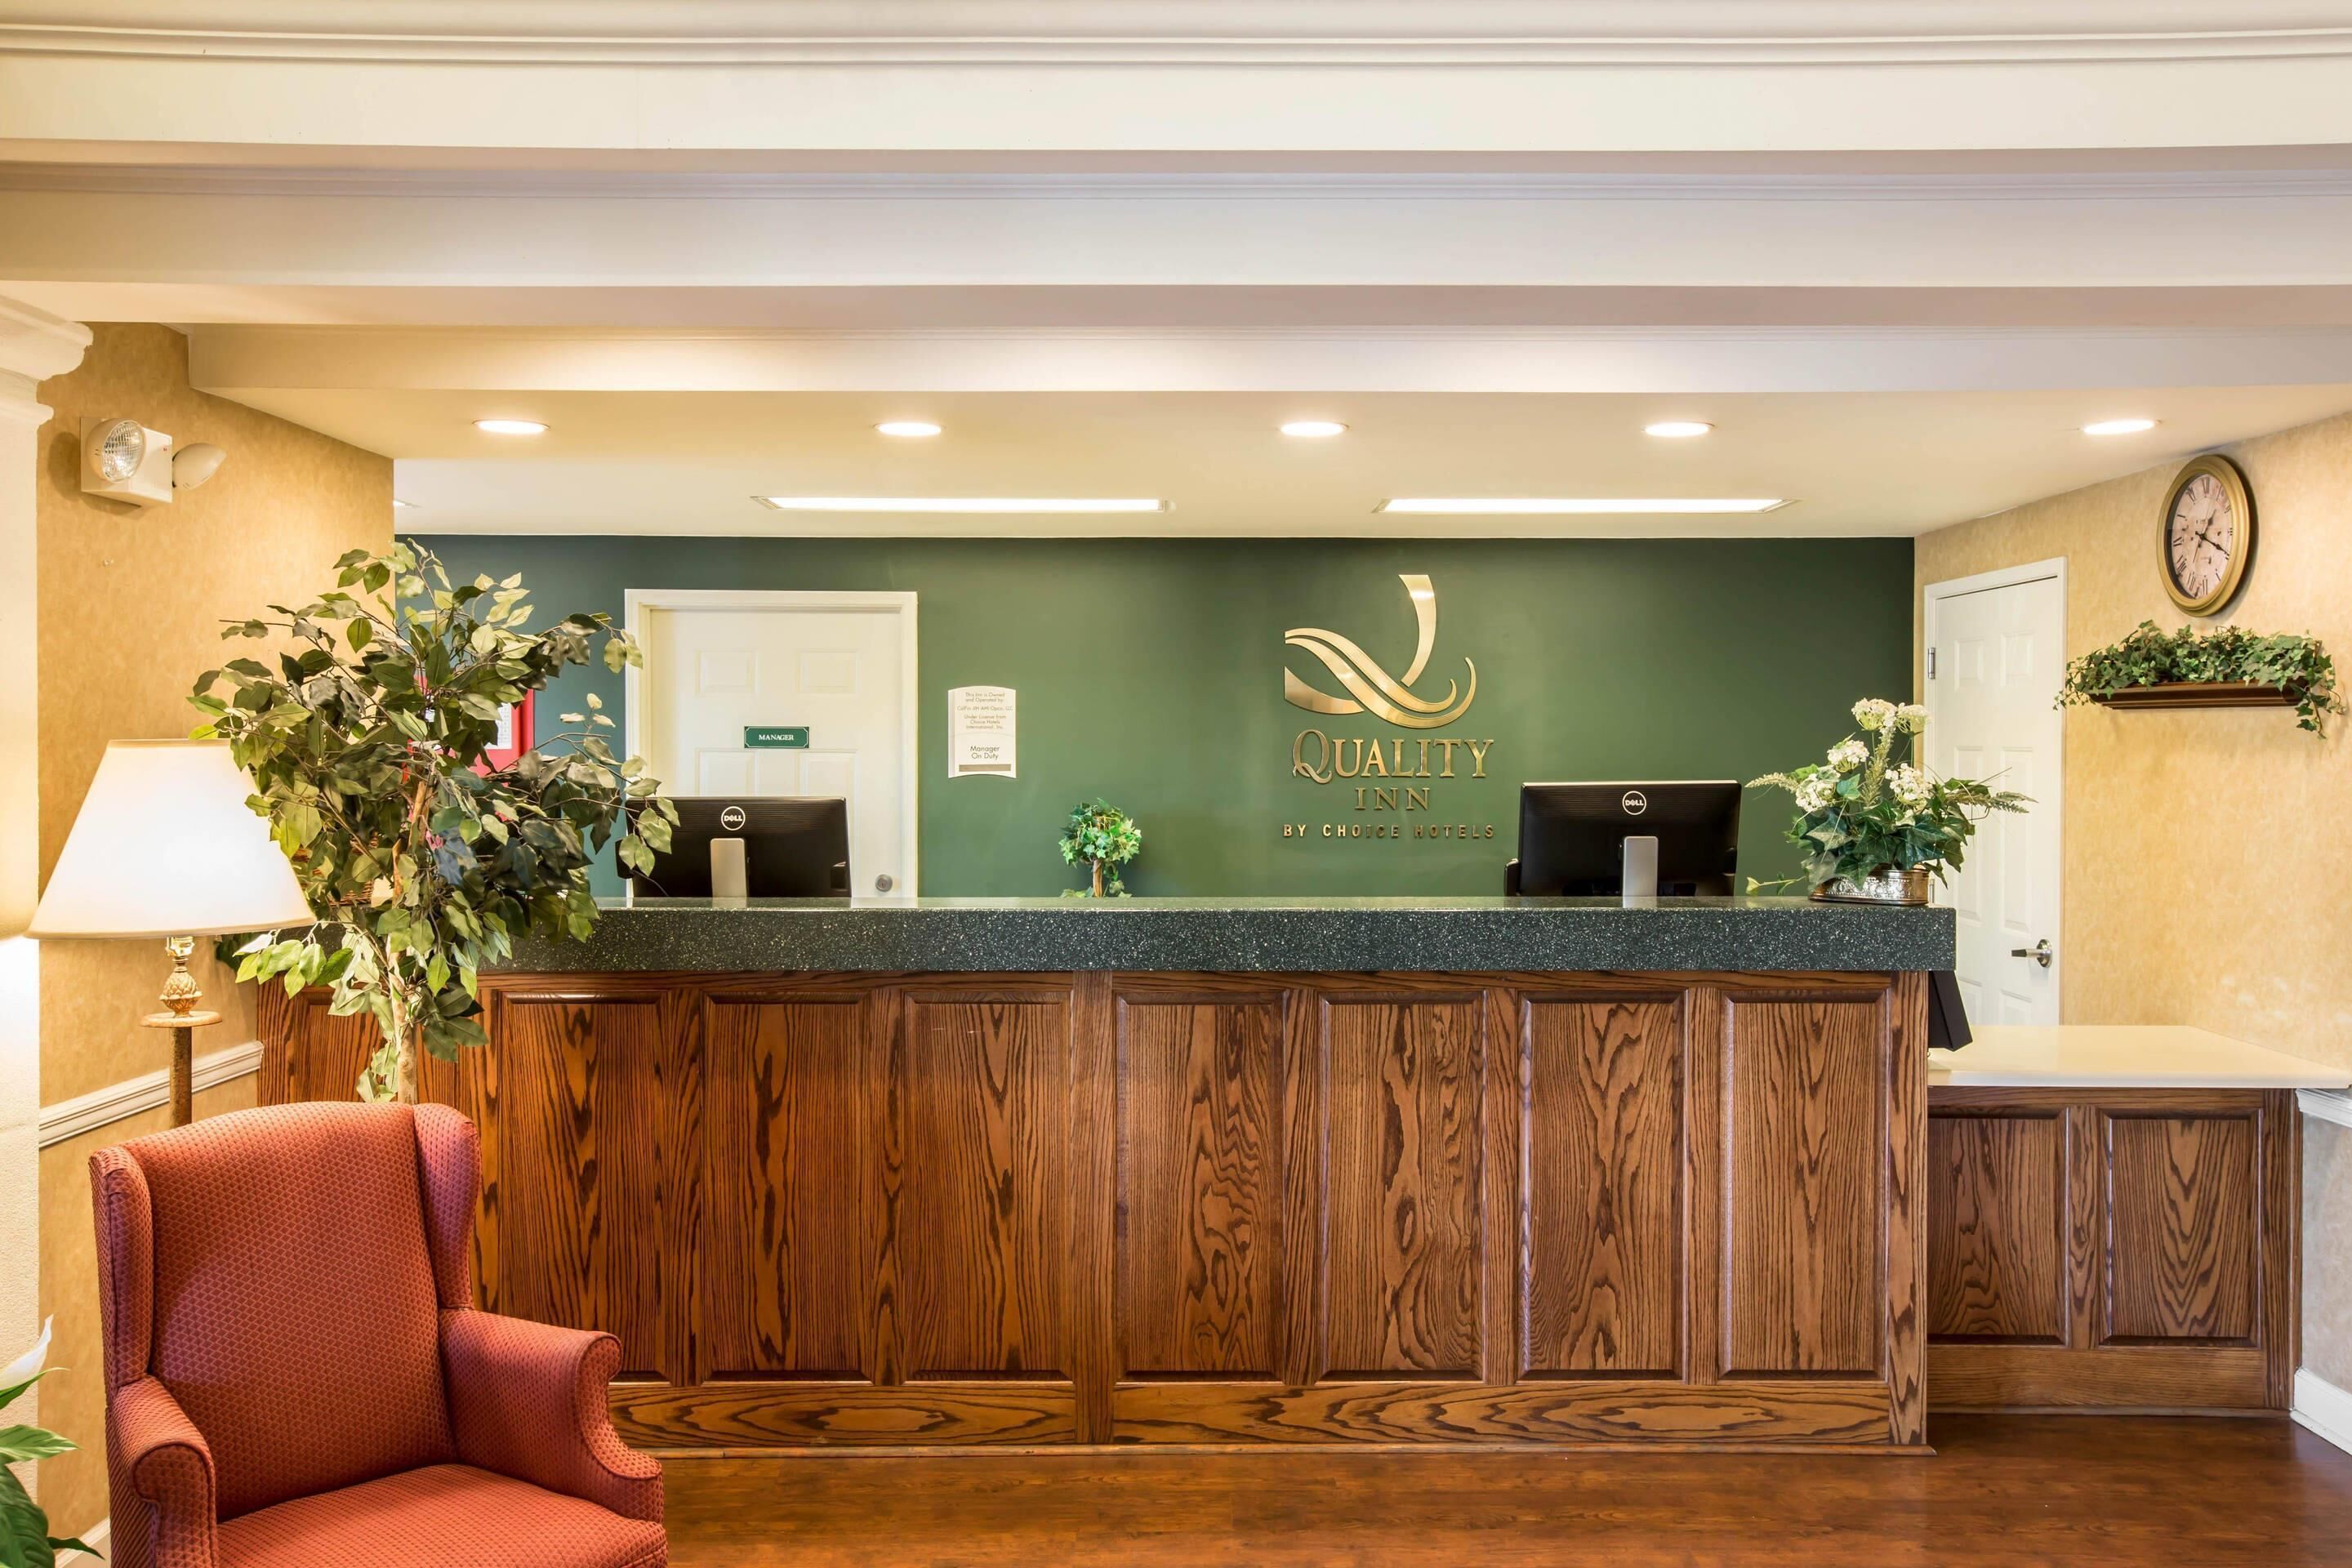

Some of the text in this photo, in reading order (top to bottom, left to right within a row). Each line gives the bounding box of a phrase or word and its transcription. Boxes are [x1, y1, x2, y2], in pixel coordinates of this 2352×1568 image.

[1292, 729, 1494, 784] QUALITY
[1355, 787, 1430, 810] INN
[1284, 824, 1494, 838] BY CHOICE HOTELS
